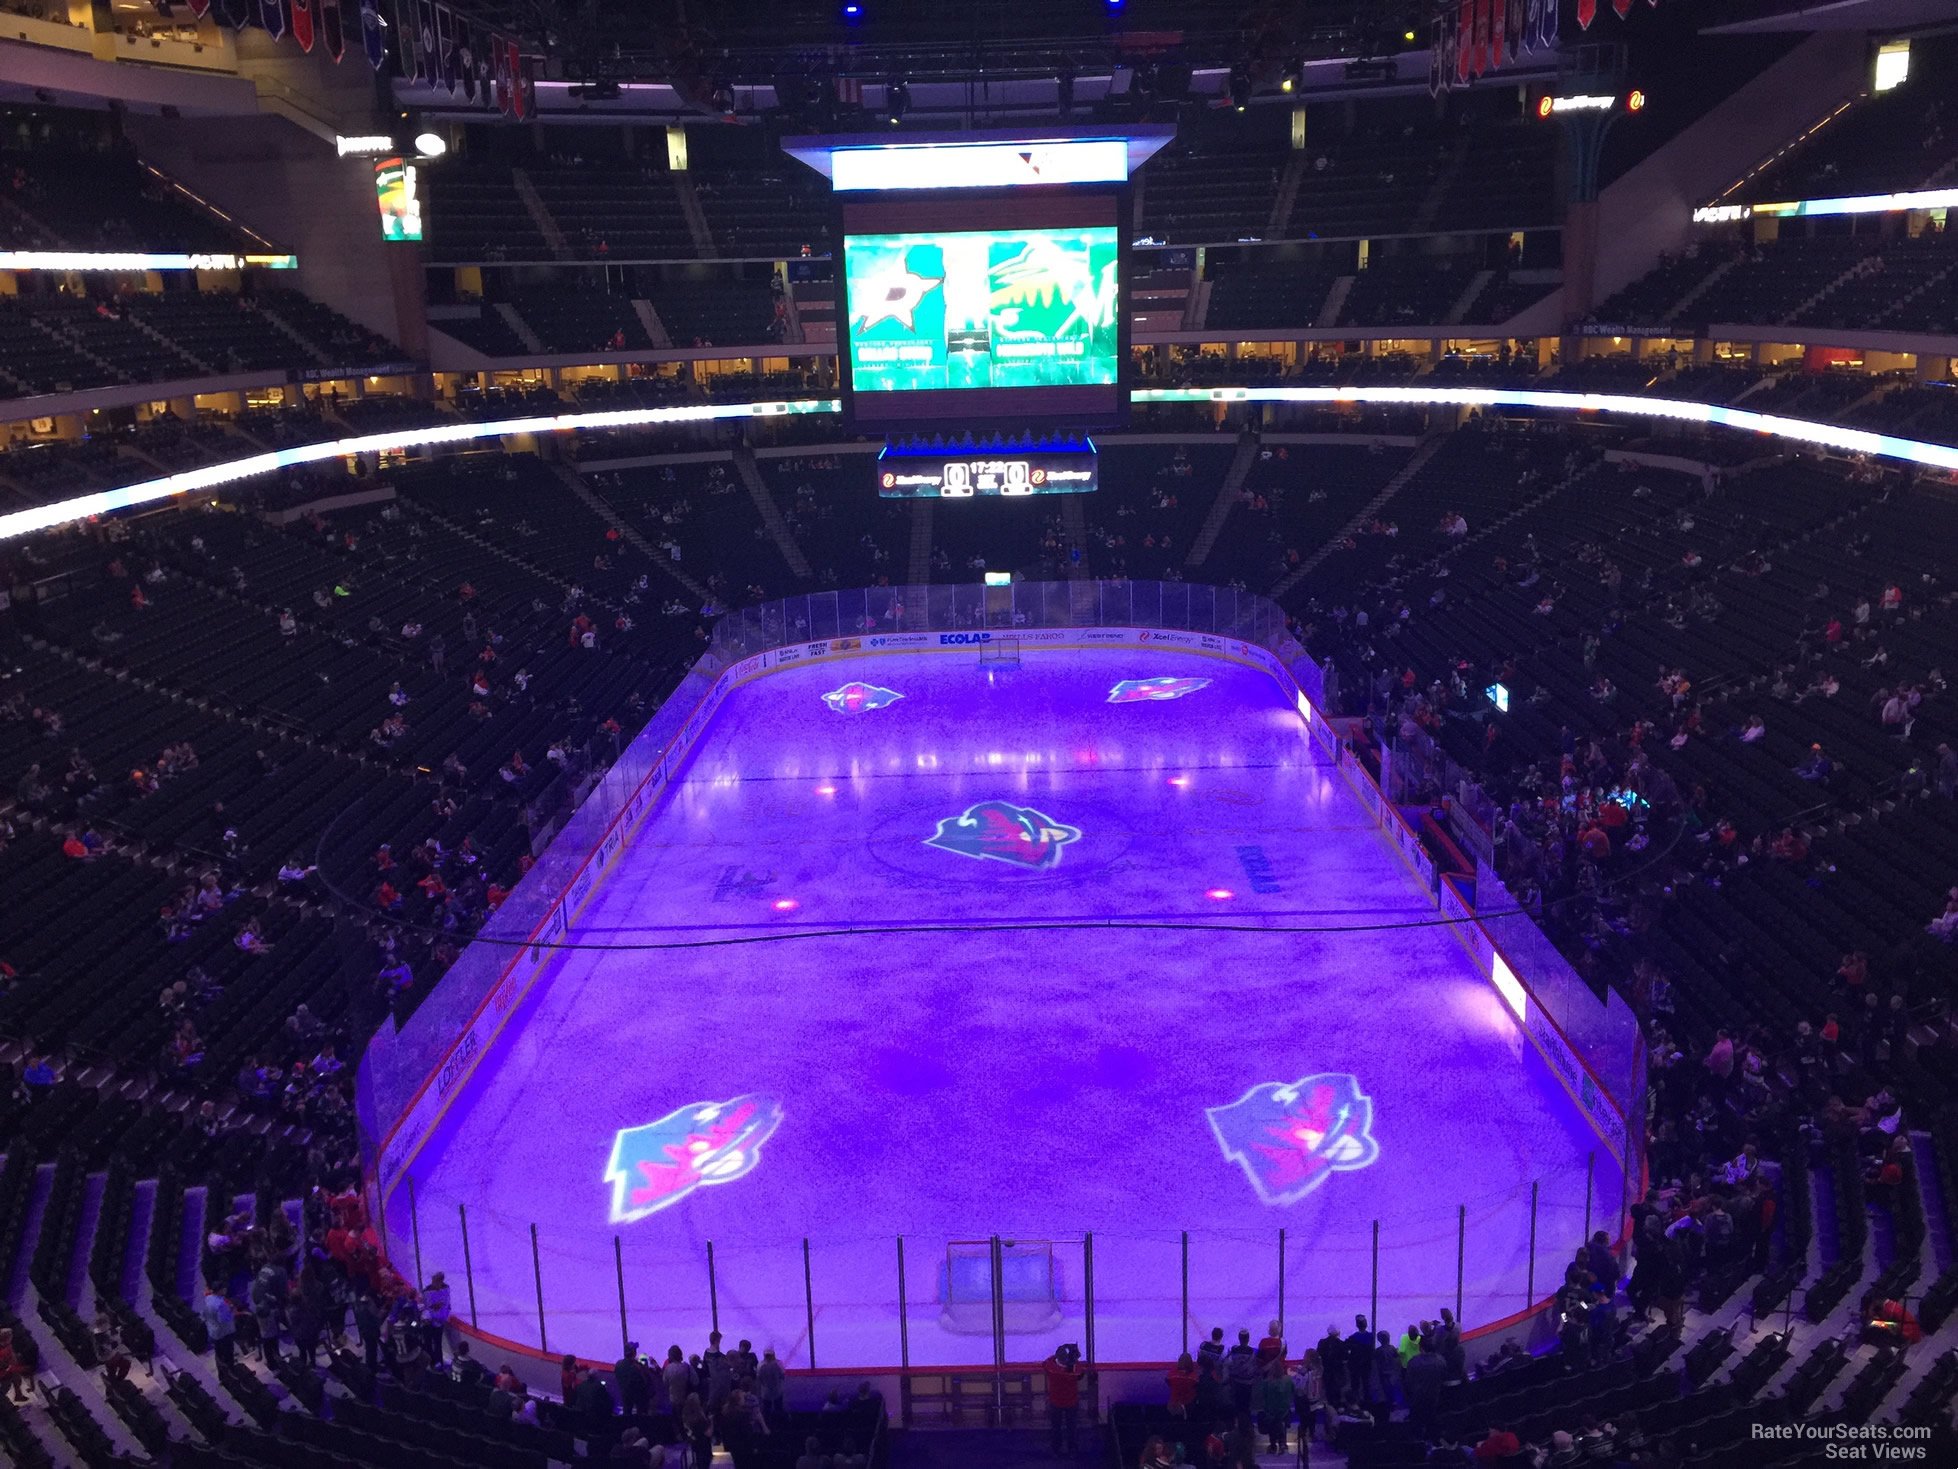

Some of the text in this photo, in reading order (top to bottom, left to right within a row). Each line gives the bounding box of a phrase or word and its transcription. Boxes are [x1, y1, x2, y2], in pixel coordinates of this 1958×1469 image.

[1600, 325, 1625, 335] Wealth
[1626, 326, 1671, 337] Management
[346, 366, 390, 376] Management
[940, 633, 991, 645] ECOLAB
[808, 642, 828, 650] FRESH
[811, 649, 826, 657] FAST
